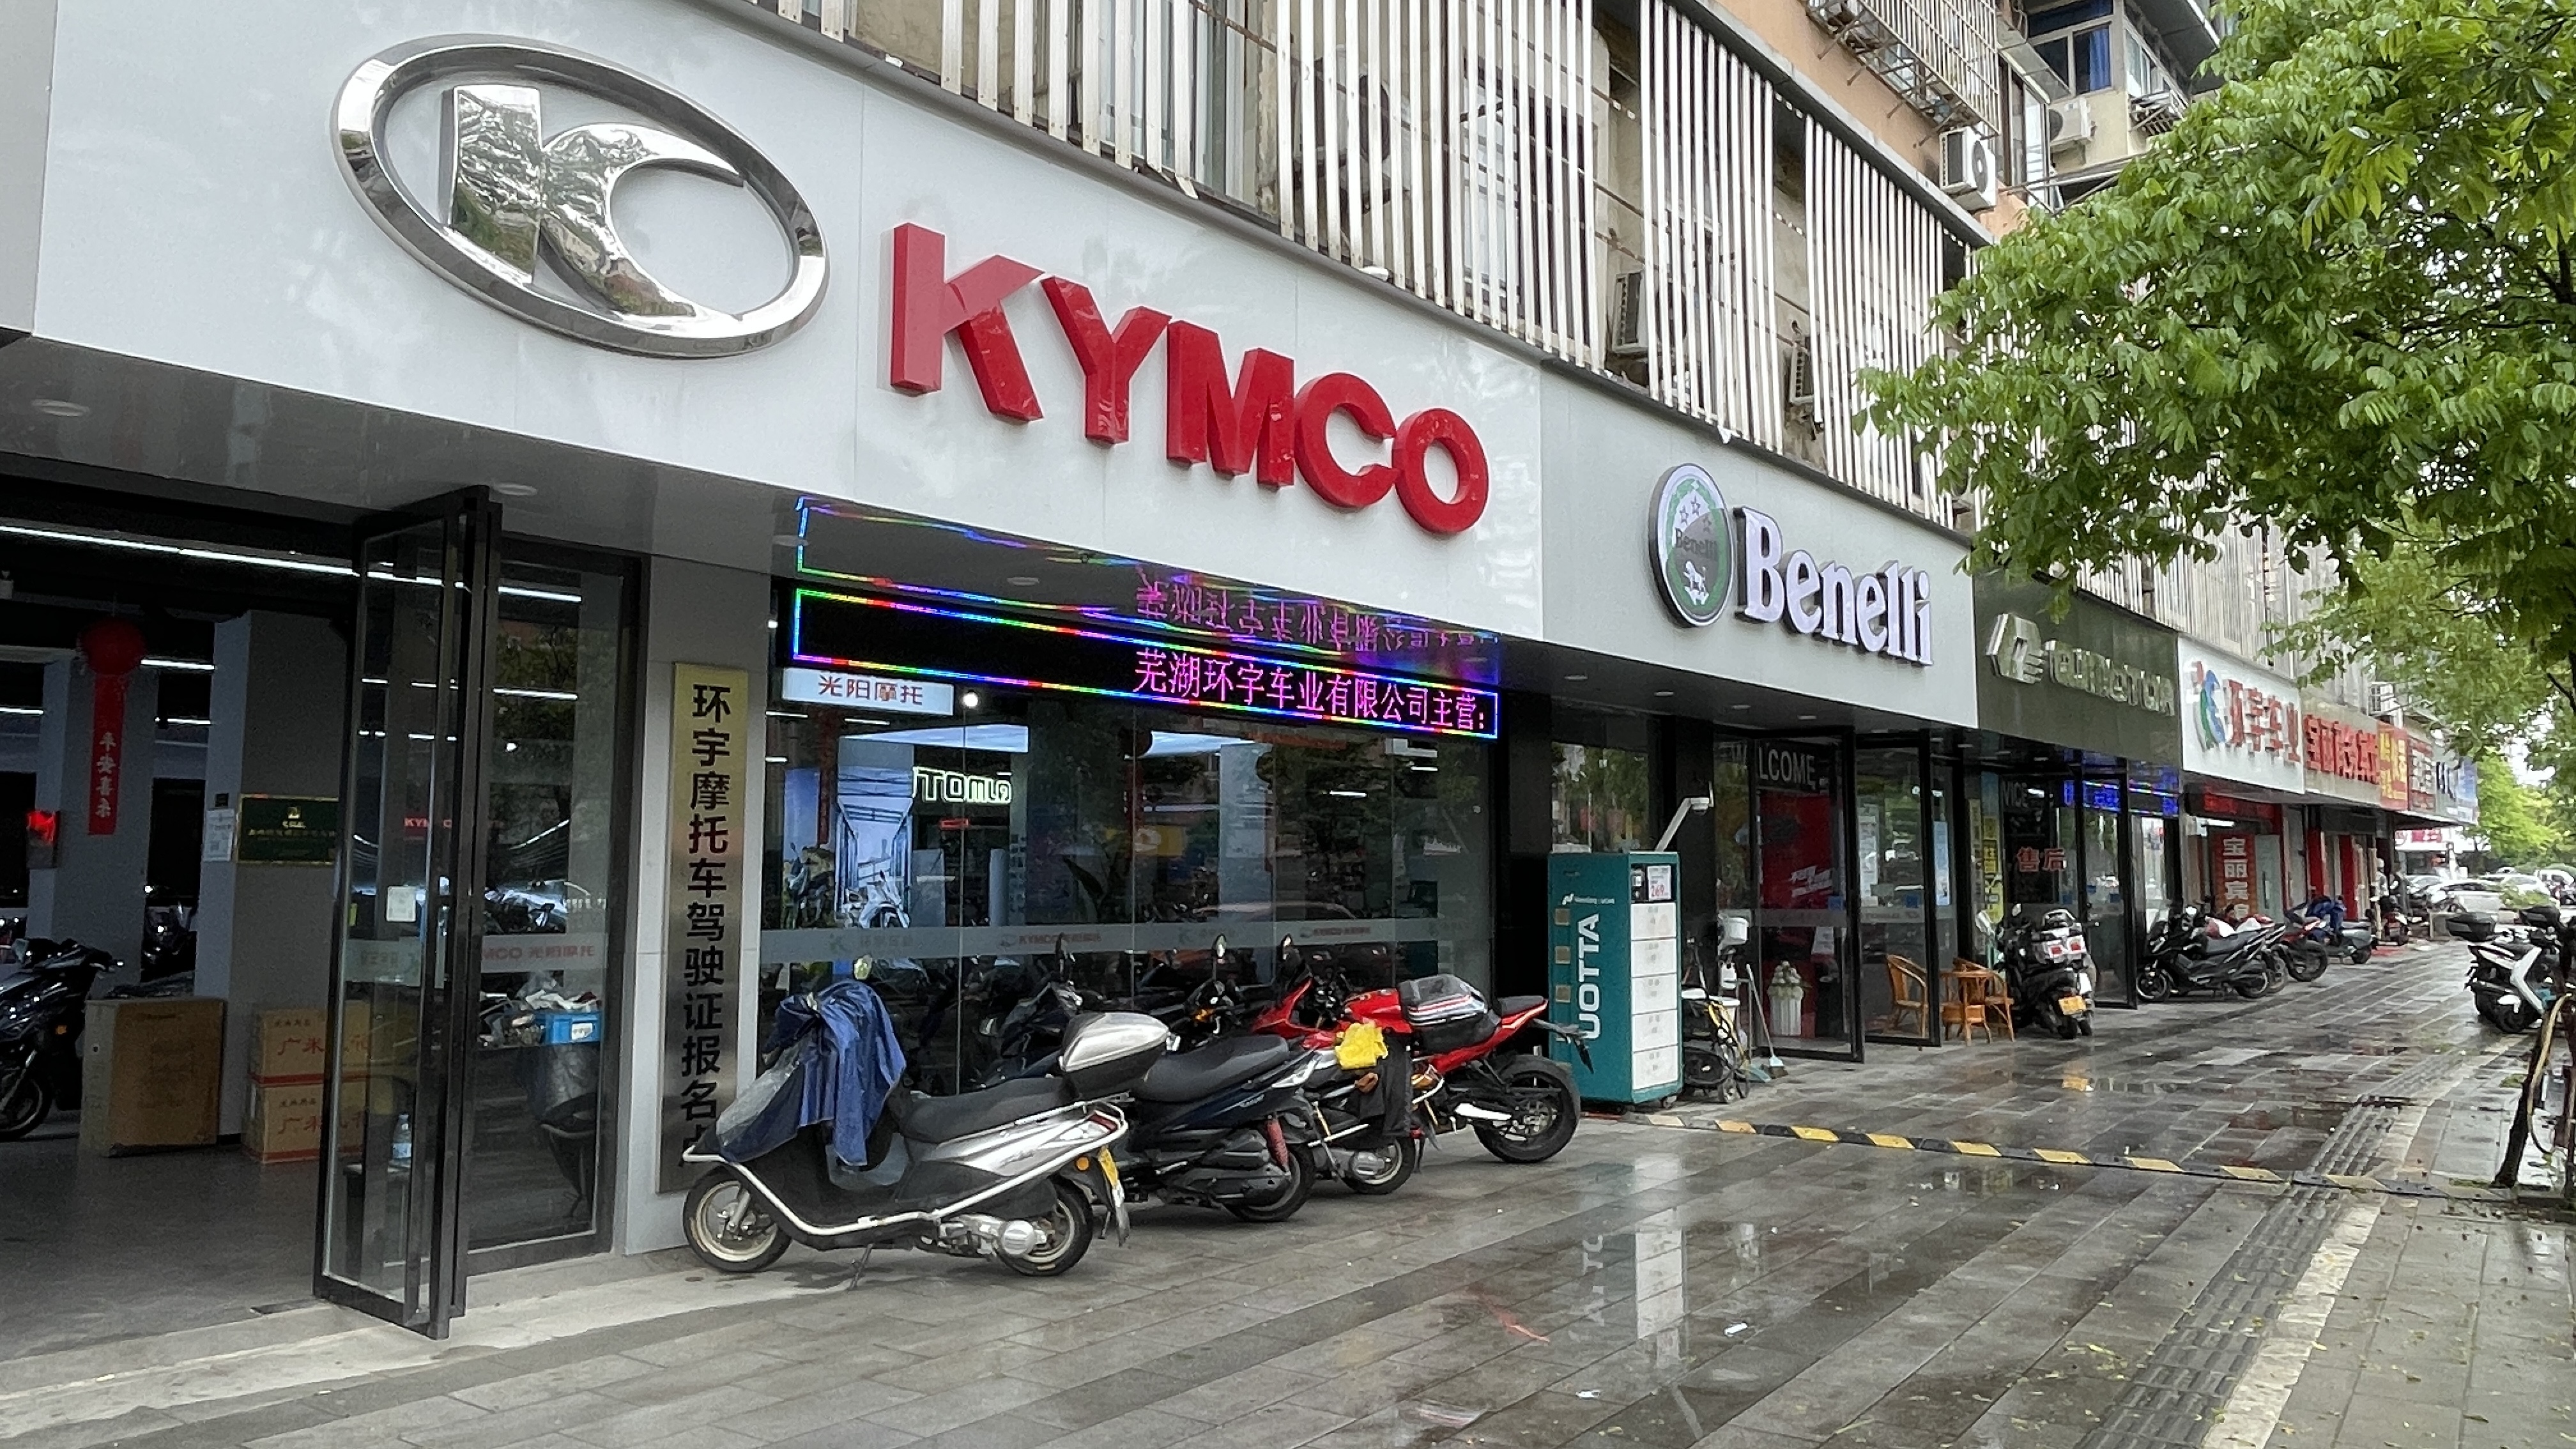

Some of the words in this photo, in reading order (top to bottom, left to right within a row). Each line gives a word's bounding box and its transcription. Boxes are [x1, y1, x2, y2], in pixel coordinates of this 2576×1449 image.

[889, 222, 1489, 534] KYMCO
[1675, 528, 1718, 560] Benelli
[1735, 506, 1933, 666] Benelli
[818, 675, 924, 705] 光阳摩托
[2017, 846, 2066, 873] 售后
[1578, 914, 1600, 1039] UOTTA
